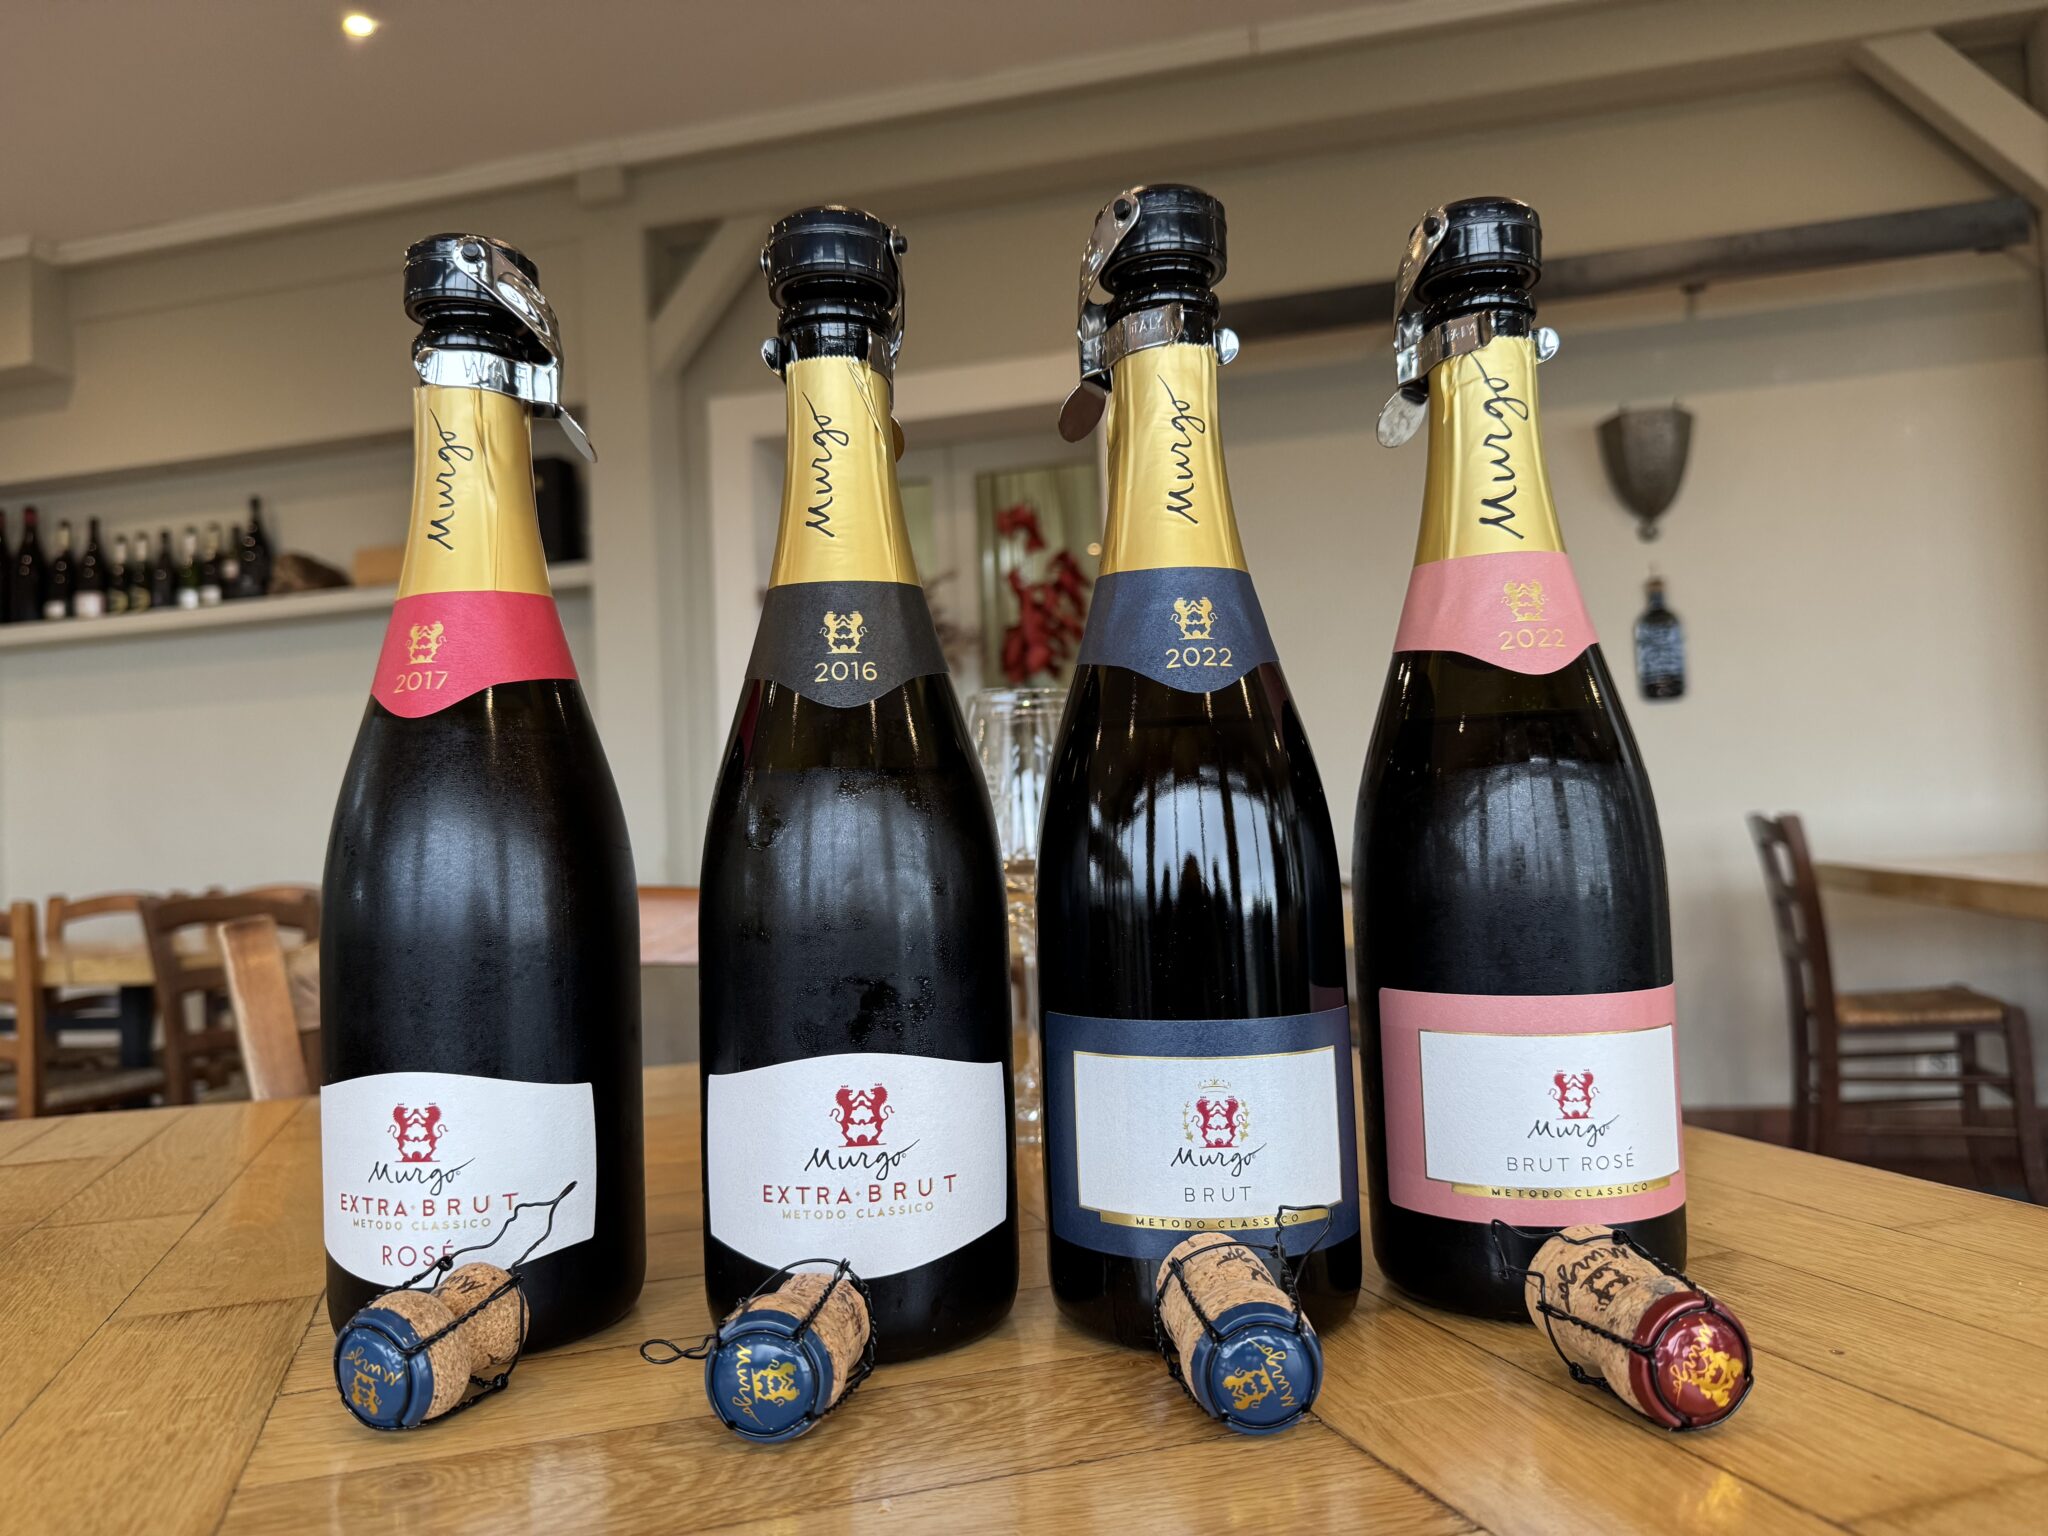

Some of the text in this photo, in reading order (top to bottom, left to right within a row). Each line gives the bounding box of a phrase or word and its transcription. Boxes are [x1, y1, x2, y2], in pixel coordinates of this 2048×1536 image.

[1157, 374, 1206, 524] Murgo
[1471, 352, 1528, 540] Murgo
[802, 391, 850, 538] Murgo
[427, 408, 473, 551] Murgo
[1498, 627, 1567, 651] 2022
[814, 660, 878, 684] 2016
[1165, 646, 1234, 670] 2022
[393, 670, 448, 694] 2017
[1527, 1114, 1620, 1148] Murgo
[804, 1138, 920, 1181] Murgo
[1170, 1142, 1267, 1178] Murgo
[1506, 1146, 1635, 1172] BRUT ROSÉ
[368, 1157, 476, 1196] Murgo
[762, 1173, 957, 1205] EXTRA BRUT
[1491, 1182, 1649, 1198] METODO CLASSICO
[340, 1192, 519, 1217] EXTRA BRUT
[1184, 1185, 1252, 1203] BRUT
[353, 1218, 492, 1232] METODO CLASSICO
[782, 1202, 934, 1220] METODO CLASSICO
[1136, 1217, 1206, 1229] METODO
[732, 1342, 765, 1426] Murgo
[1247, 1339, 1299, 1407] Murgo
